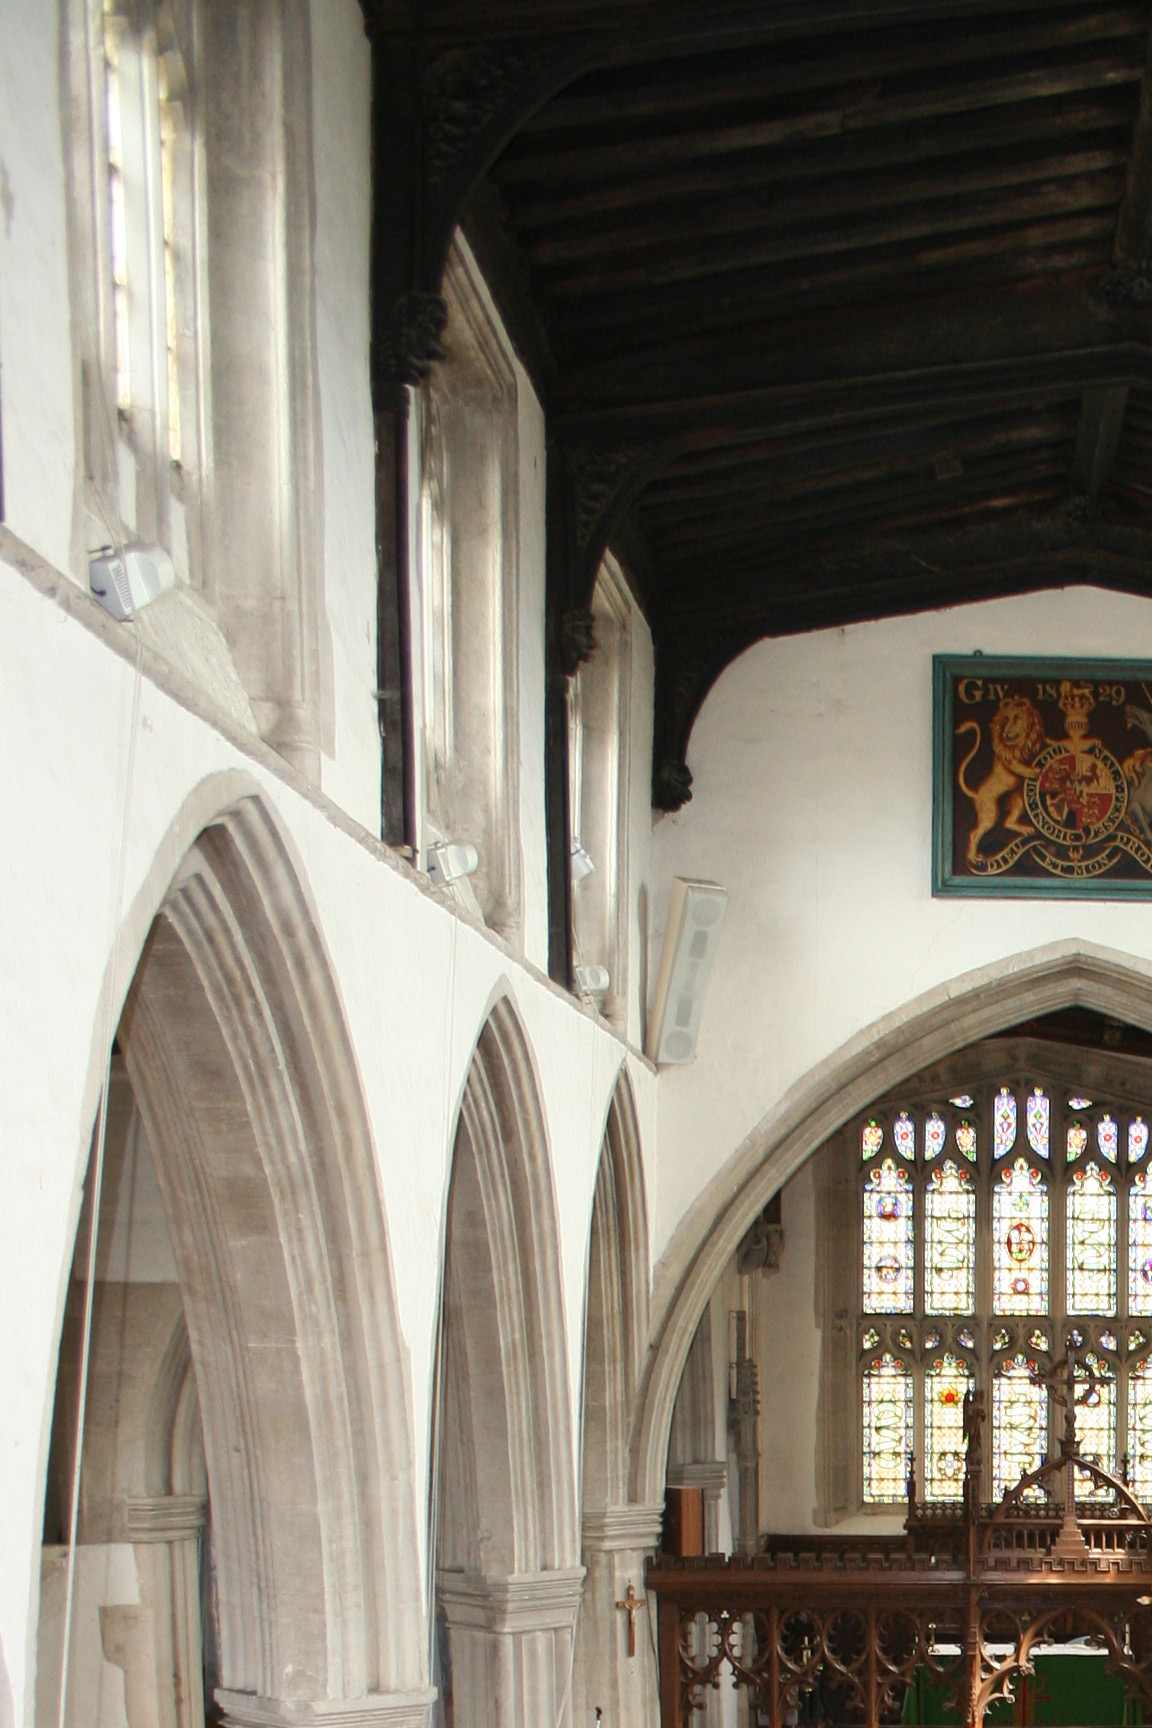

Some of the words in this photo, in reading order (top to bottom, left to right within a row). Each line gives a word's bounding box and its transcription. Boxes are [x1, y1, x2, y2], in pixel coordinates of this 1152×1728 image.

[1036, 684, 1057, 700] 18
[1099, 686, 1125, 706] 29
[1073, 855, 1108, 876] MON
